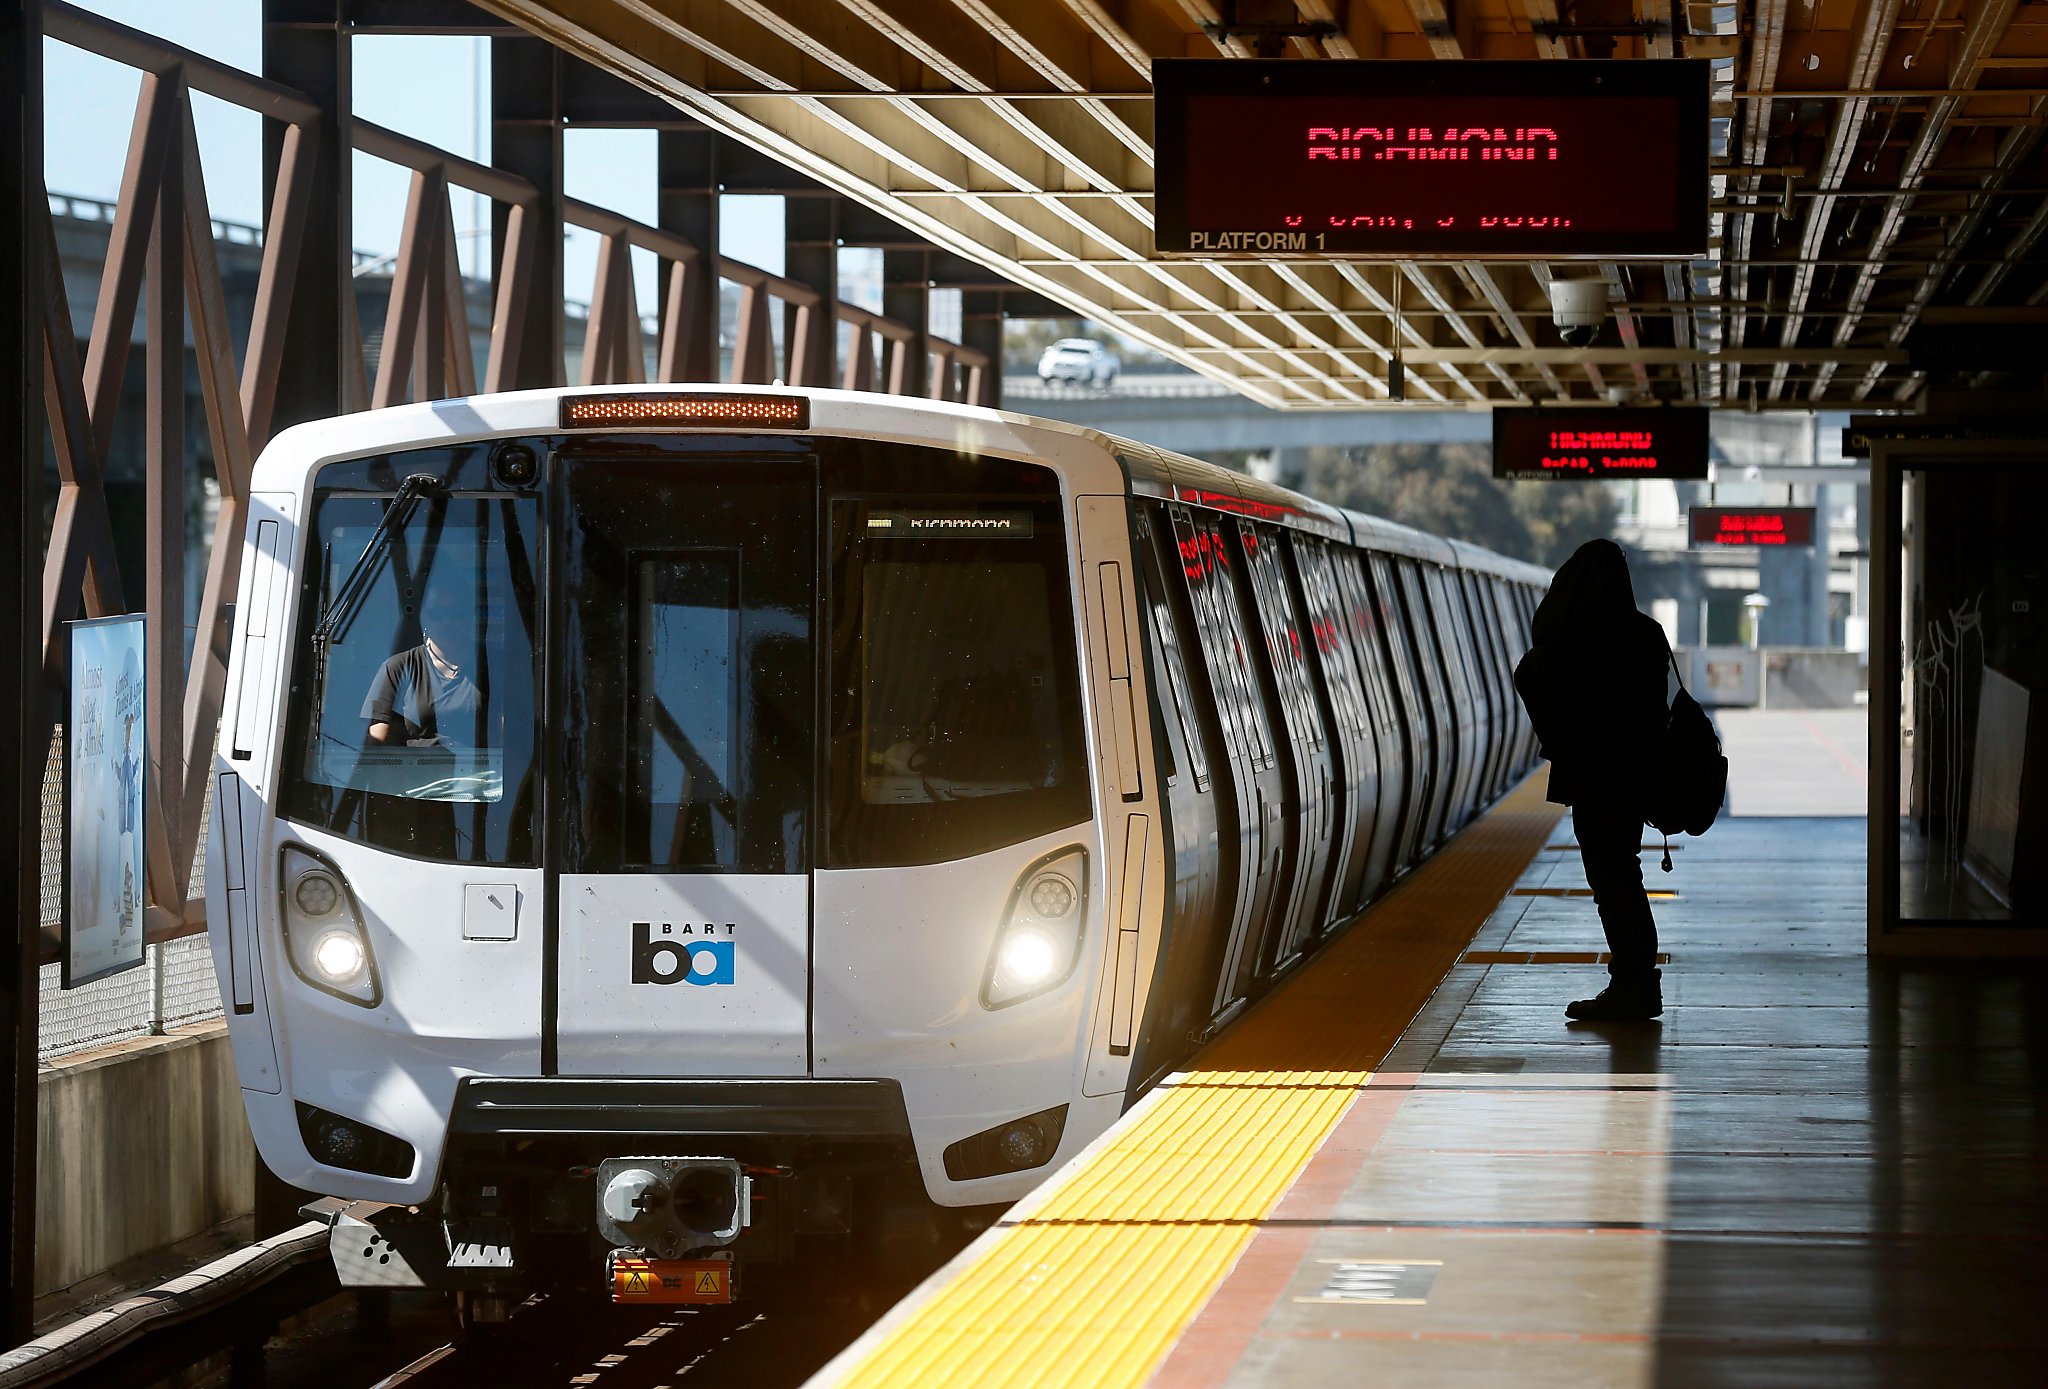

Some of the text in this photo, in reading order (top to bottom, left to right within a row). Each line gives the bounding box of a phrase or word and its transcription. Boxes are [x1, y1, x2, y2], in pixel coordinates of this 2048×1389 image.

[1307, 127, 1559, 160] RICHMOND
[1190, 232, 1326, 250] PLATFORM 1
[662, 923, 736, 935] BART
[631, 922, 735, 986] ba
